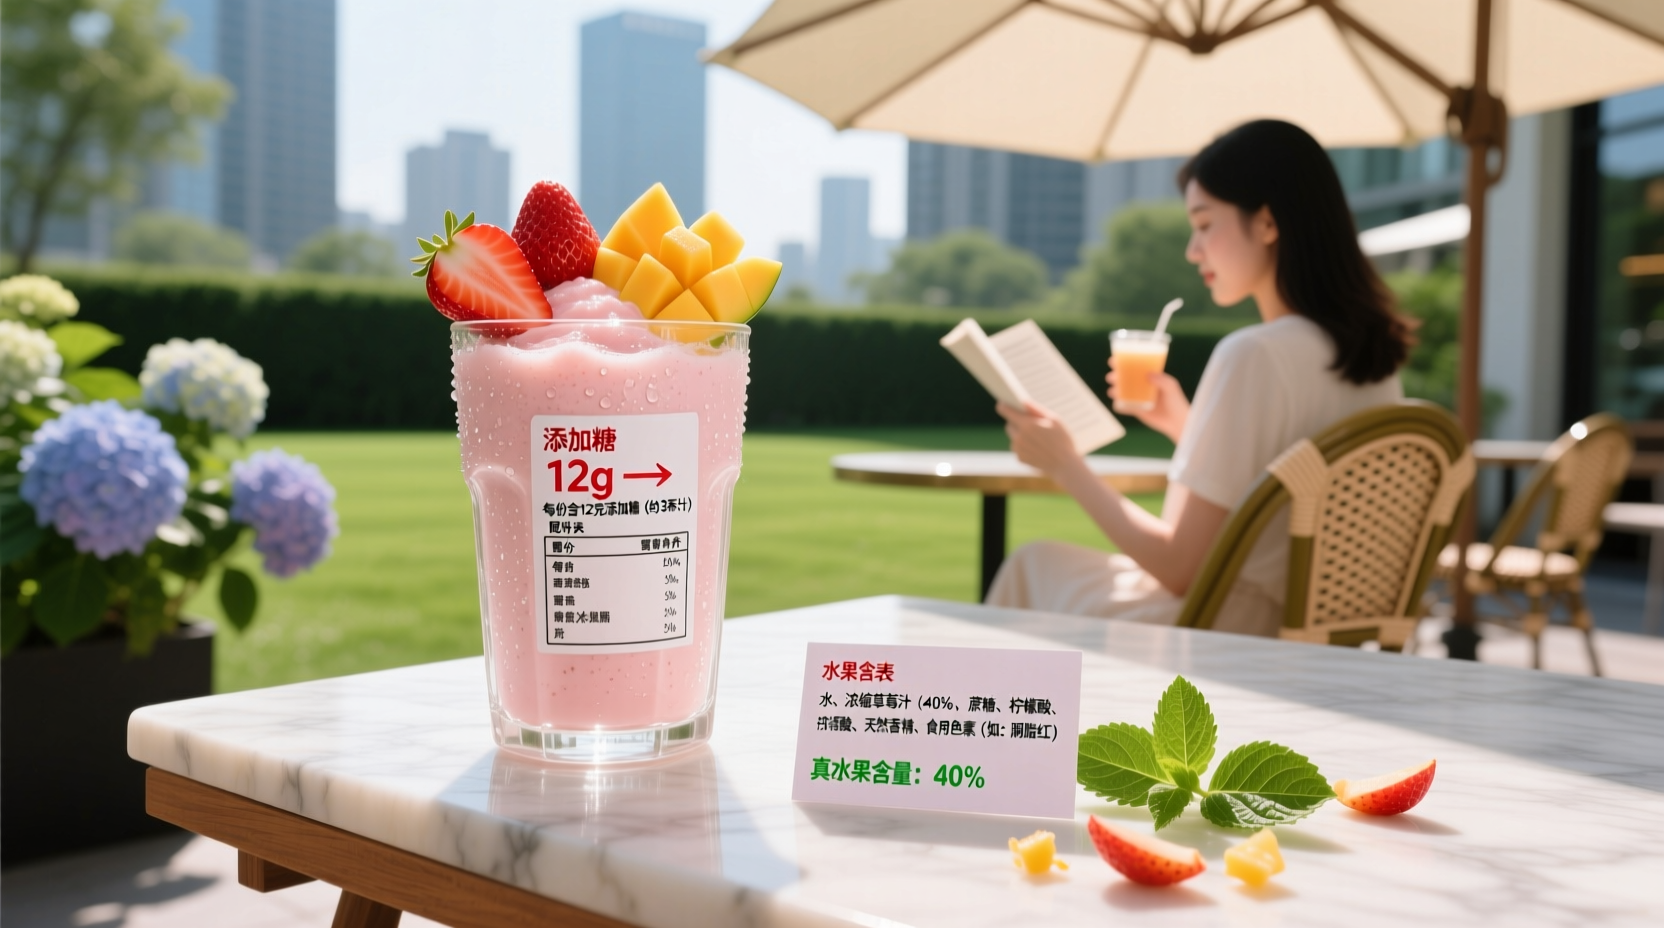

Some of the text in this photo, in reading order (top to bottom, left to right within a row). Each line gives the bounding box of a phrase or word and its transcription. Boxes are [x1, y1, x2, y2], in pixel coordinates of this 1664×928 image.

[543, 427, 616, 452] 添加糖
[548, 459, 613, 500] 12g
